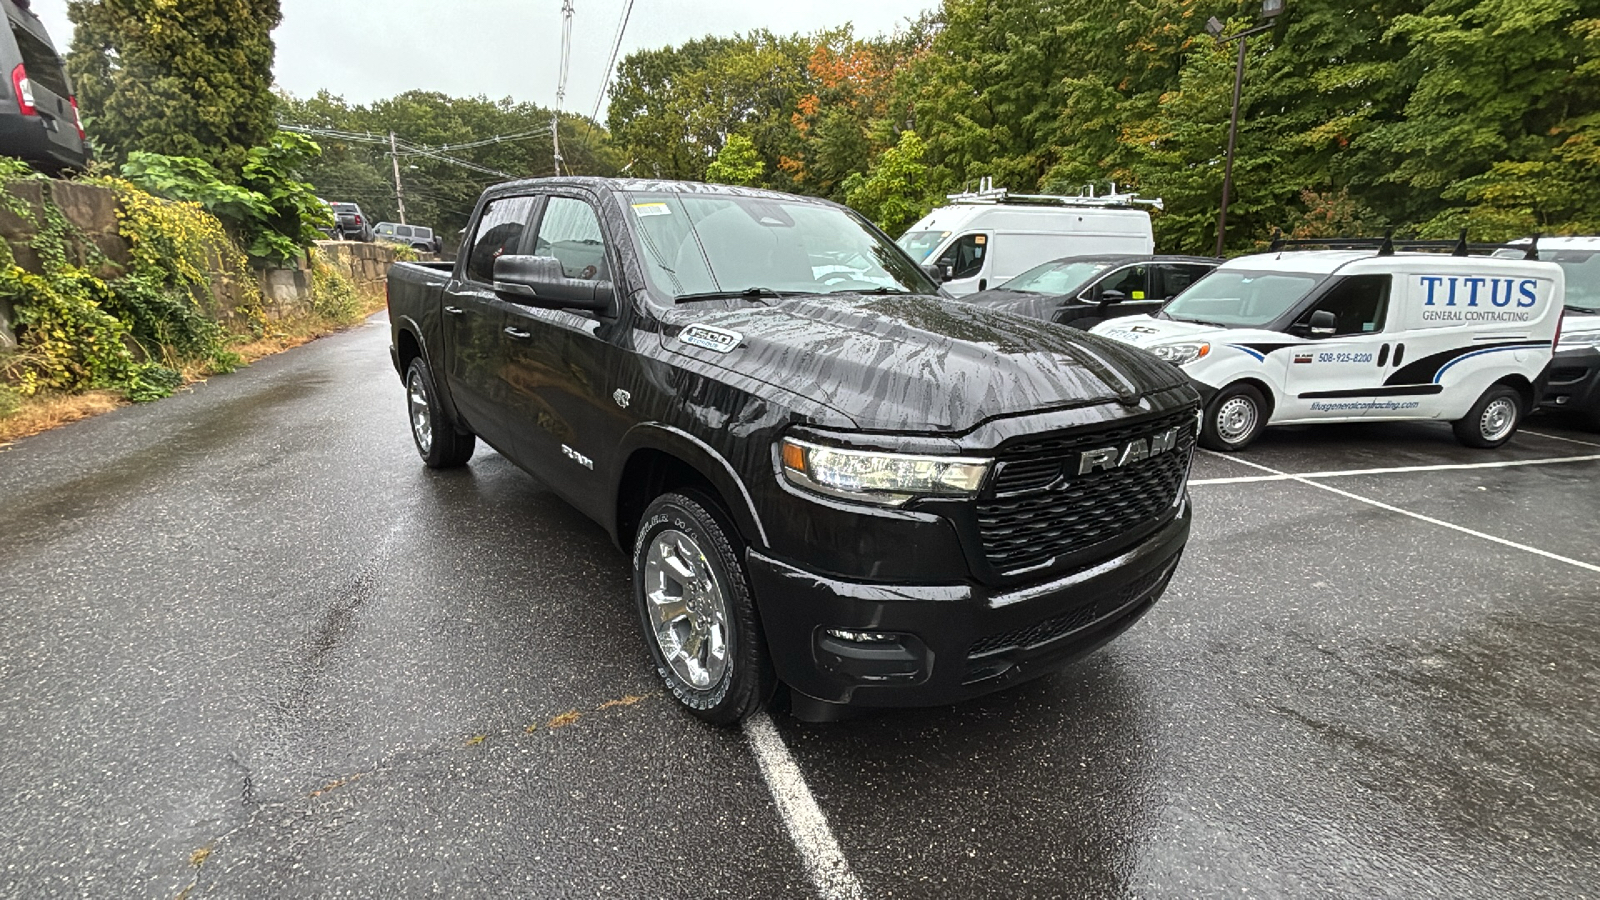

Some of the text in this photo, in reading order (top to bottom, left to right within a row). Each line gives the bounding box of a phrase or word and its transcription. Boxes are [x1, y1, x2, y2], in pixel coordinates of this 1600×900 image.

[1420, 276, 1537, 307] TITUS
[1422, 310, 1529, 322] GENERAL CONTRACTING
[1318, 353, 1373, 363] 508-925-8200
[1309, 400, 1420, 412] titusgeneralcontracting.com
[561, 444, 594, 471] RAM
[1078, 426, 1180, 475] RAM
